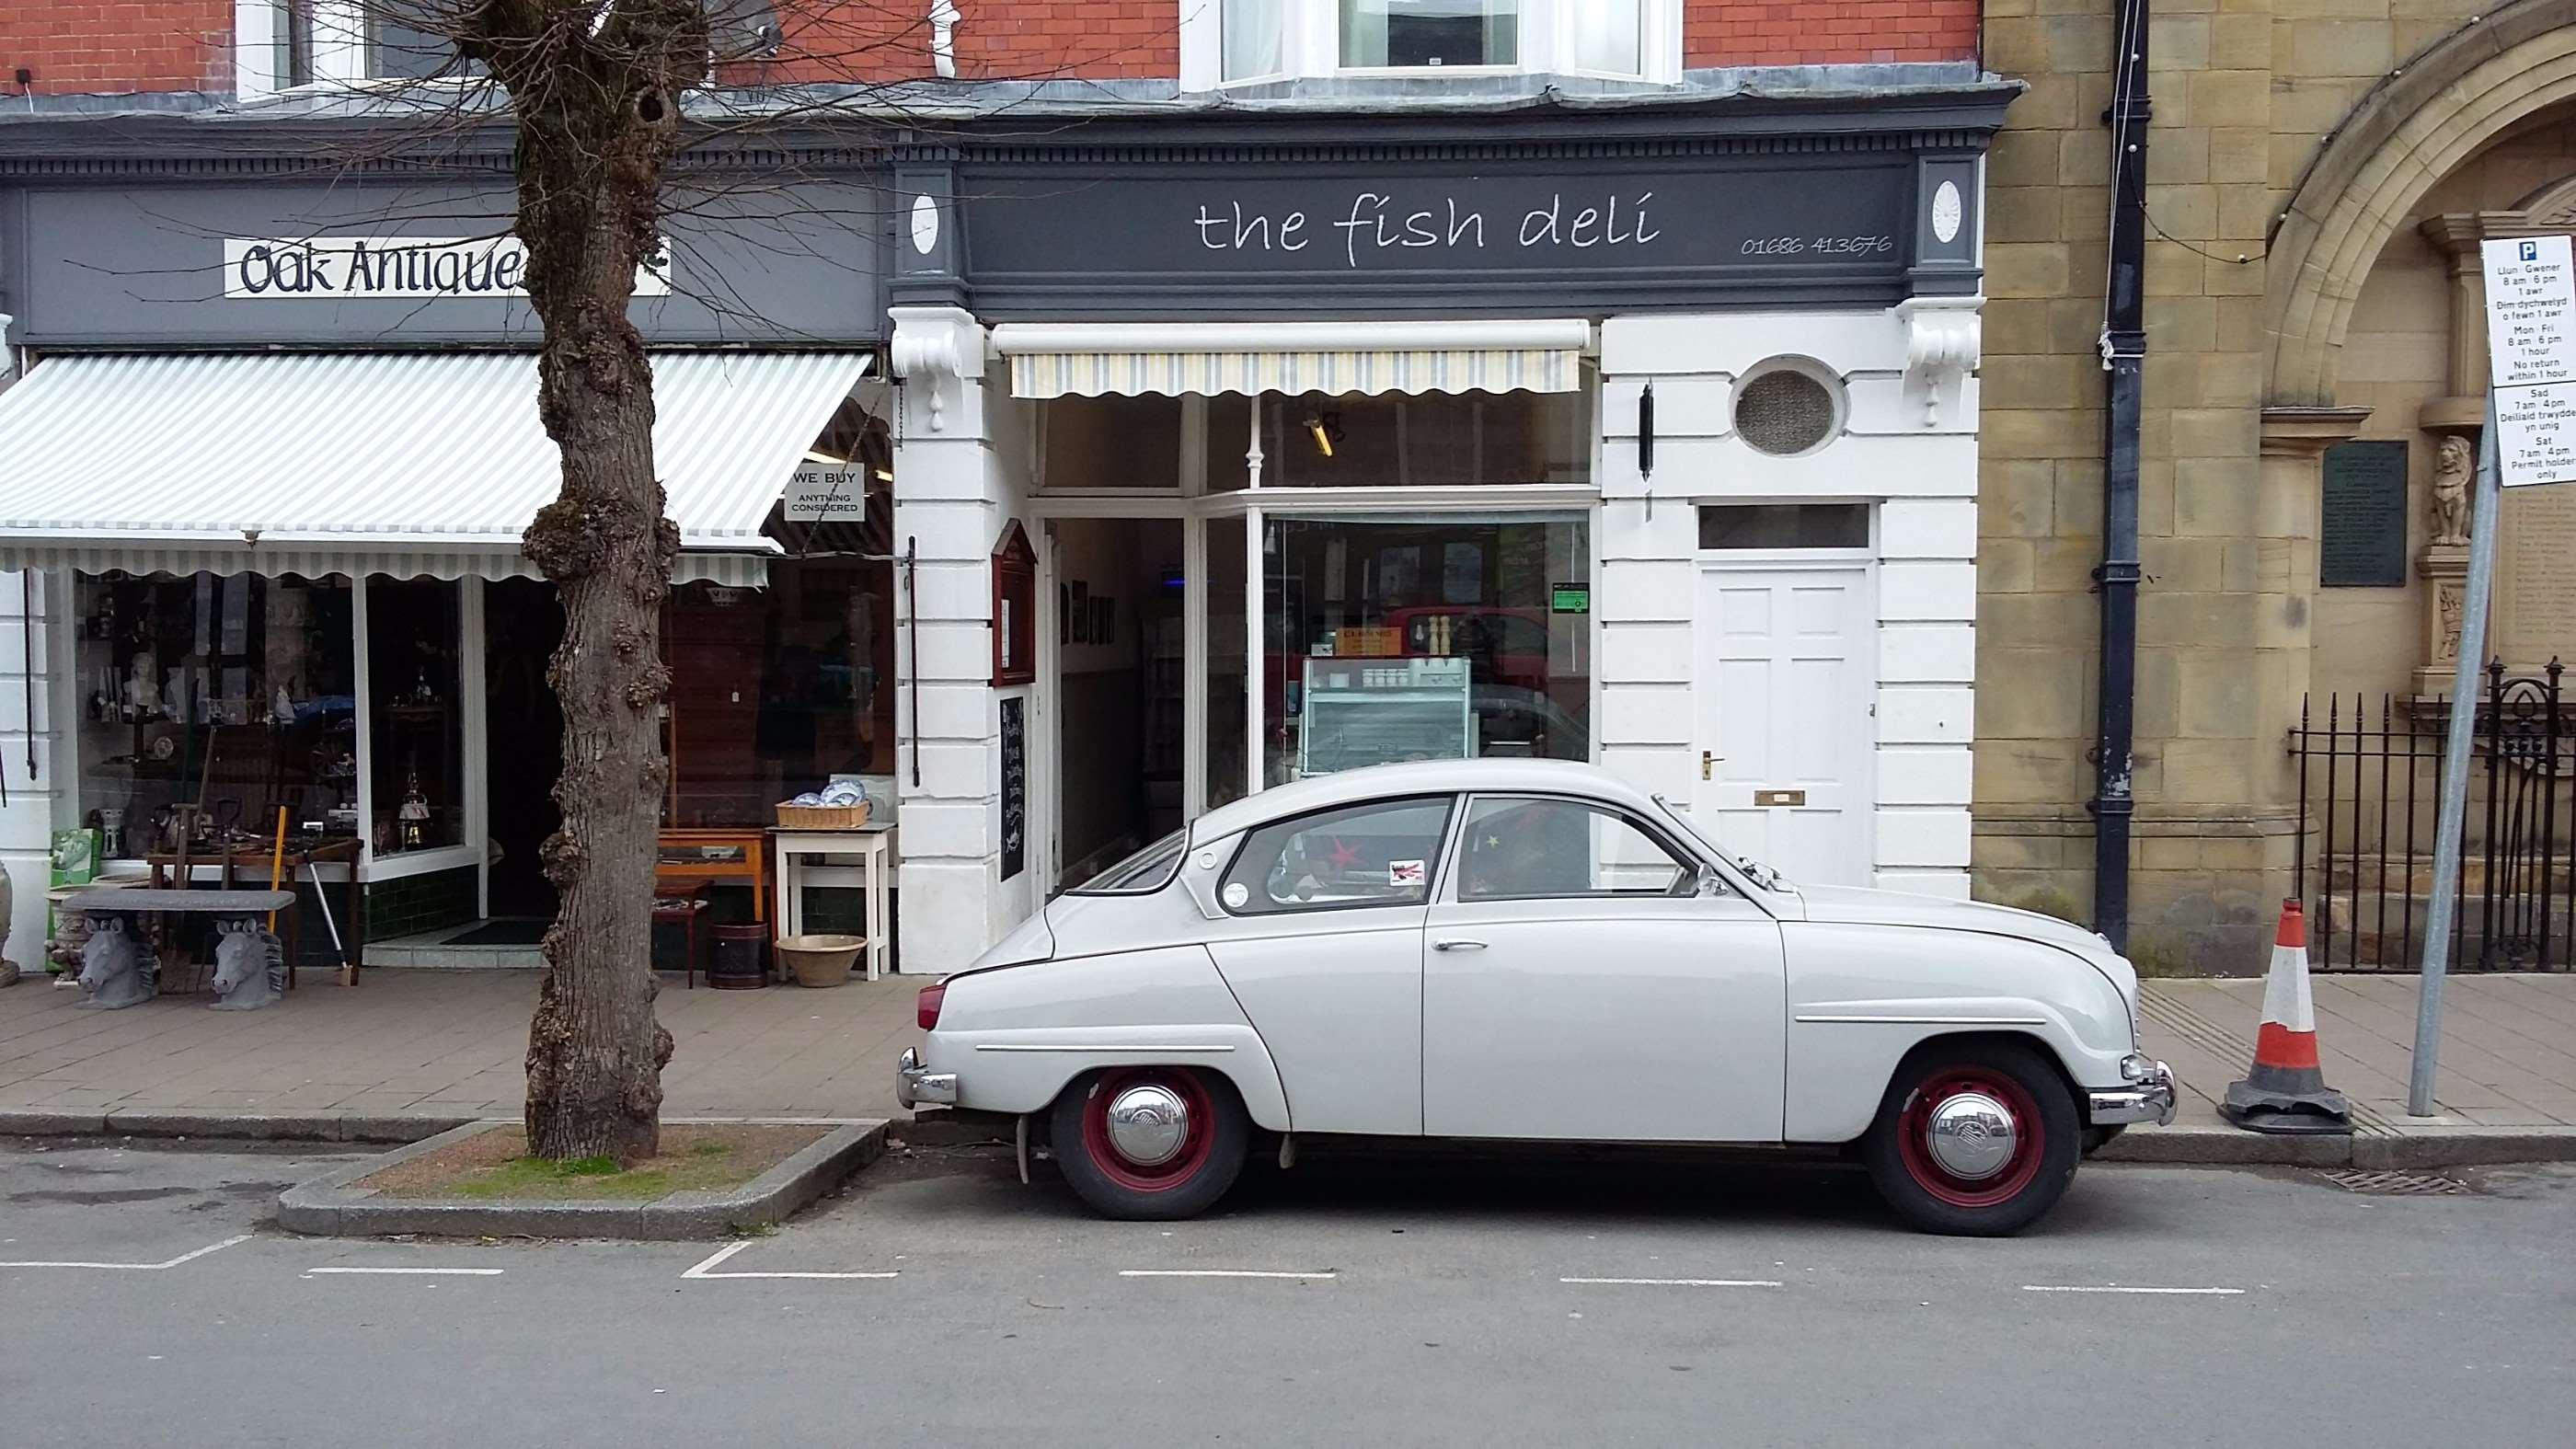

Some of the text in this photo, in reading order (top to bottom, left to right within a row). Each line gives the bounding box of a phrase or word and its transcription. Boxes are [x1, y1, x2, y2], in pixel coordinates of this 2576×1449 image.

[1195, 191, 1660, 267] the fish deli
[1742, 236, 1892, 257] 01686 413676
[240, 241, 522, 294] Oak Antique
[2498, 264, 2560, 275] Llun Gwener
[2503, 277, 2510, 285] 8
[2534, 275, 2540, 283] 6
[2543, 275, 2557, 285] pm
[2525, 287, 2543, 295] awr
[2497, 297, 2568, 310] Dim dychwelyd
[2512, 311, 2535, 320] fewn
[2545, 309, 2562, 317] awr
[2513, 324, 2555, 335] Mon Fri
[2508, 335, 2562, 346] 8 am 6 pm
[2528, 346, 2550, 356] hour
[2513, 359, 2560, 370] No return
[2507, 371, 2536, 381] within
[2546, 368, 2569, 377] hour
[2530, 389, 2548, 398] Sad
[2501, 409, 2576, 423] Deiliaid trwydde
[2525, 422, 2559, 433] yn unig
[2536, 437, 2552, 446] Sat
[2512, 457, 2576, 470] Permit holder
[793, 473, 856, 483] WE BUY
[2536, 470, 2558, 480] only
[799, 494, 851, 502] ANYTHING
